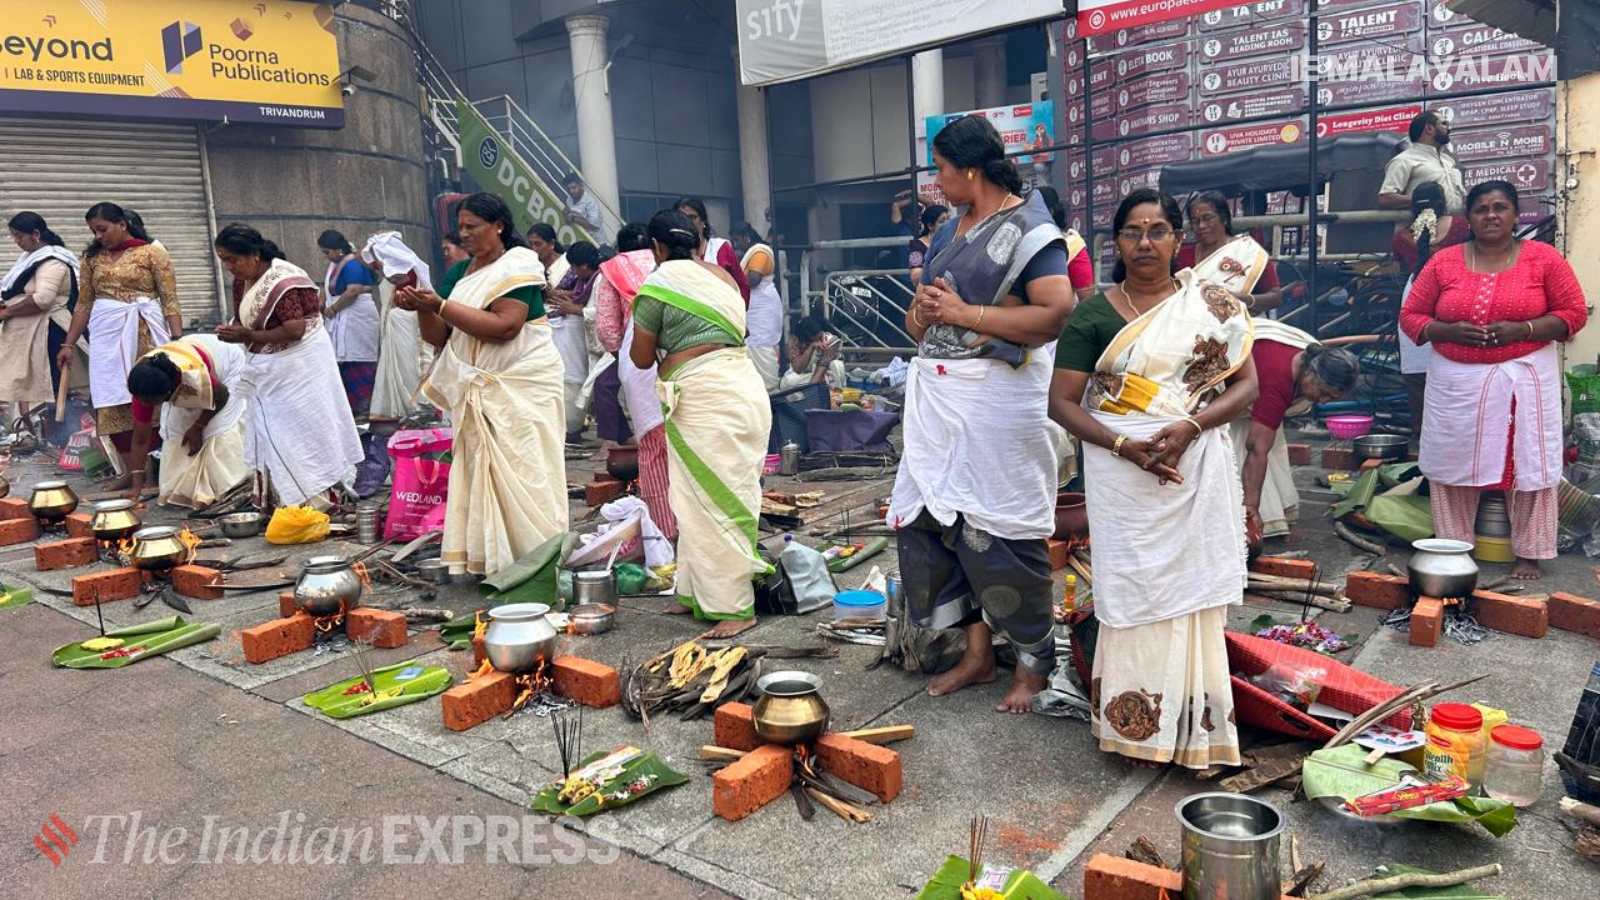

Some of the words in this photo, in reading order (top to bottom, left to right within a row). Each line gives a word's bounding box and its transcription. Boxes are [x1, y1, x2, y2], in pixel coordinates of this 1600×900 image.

[1231, 0, 1285, 17] TAENT
[746, 0, 801, 41] sify
[1339, 10, 1398, 29] TALENT
[1233, 31, 1269, 45] TALENT
[1272, 28, 1289, 38] IAS
[0, 35, 113, 62] eyond
[1229, 42, 1266, 54] READING
[1268, 37, 1293, 47] ROOM
[209, 43, 279, 65] Poorna
[1145, 50, 1173, 64] BOOK
[14, 68, 34, 80] LAB
[37, 69, 45, 80] &
[46, 69, 86, 83] SPORTS
[88, 71, 145, 86] EQUIPMENT
[211, 61, 330, 87] Publications
[1081, 70, 1107, 88] TLENT
[1261, 71, 1291, 82] CLINIC
[1461, 99, 1487, 108] OXYGEN
[1487, 94, 1538, 106] CONCENTRATOR
[1500, 104, 1518, 112] SLEEP
[1519, 101, 1541, 109] STUDY
[259, 106, 326, 120] TRIVANDRUM
[1158, 112, 1180, 124] SHOP
[1332, 117, 1374, 129] Longevity
[1374, 114, 1392, 123] Diet
[1393, 111, 1419, 120] Clinic
[1003, 133, 1027, 144] RIER
[1253, 134, 1281, 143] LIMITED
[1457, 140, 1496, 151] MOBILE
[1500, 138, 1509, 147] N
[1513, 135, 1545, 146] MORE
[1475, 165, 1517, 177] MEDICAL
[920, 184, 941, 192] MOB
[496, 156, 531, 203] DC
[526, 189, 577, 246] BOO
[396, 491, 442, 505] WEDLAND
